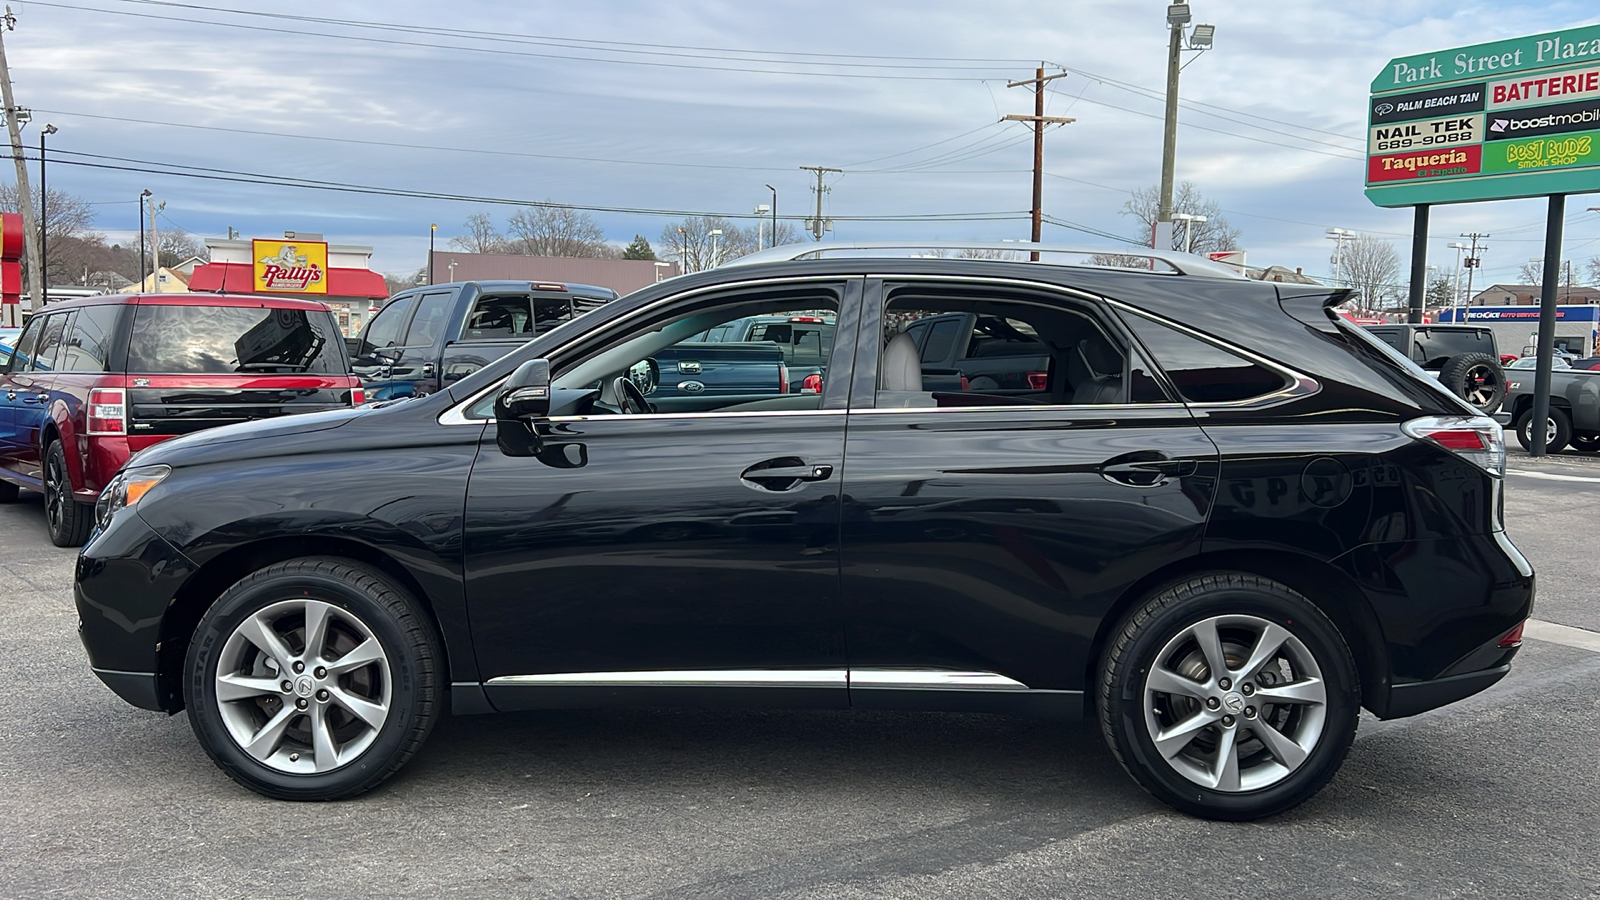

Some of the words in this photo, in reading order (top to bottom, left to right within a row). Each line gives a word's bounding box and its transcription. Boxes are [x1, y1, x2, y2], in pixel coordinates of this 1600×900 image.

[1393, 57, 1443, 84] Park
[1454, 48, 1523, 75] Street
[1536, 36, 1600, 62] Plaza
[1493, 72, 1600, 103] BATTERIE
[1397, 101, 1423, 112] PALM
[1424, 96, 1457, 109] BEACH
[1459, 92, 1480, 104] TAN
[1376, 126, 1421, 140] NAIL
[1430, 118, 1474, 133] TEK
[1510, 109, 1600, 131] boostmobil
[1378, 132, 1472, 150] 689-9088
[1518, 159, 1549, 169] SMOKE
[1551, 156, 1577, 166] SHOP
[261, 263, 322, 289] Rally's
